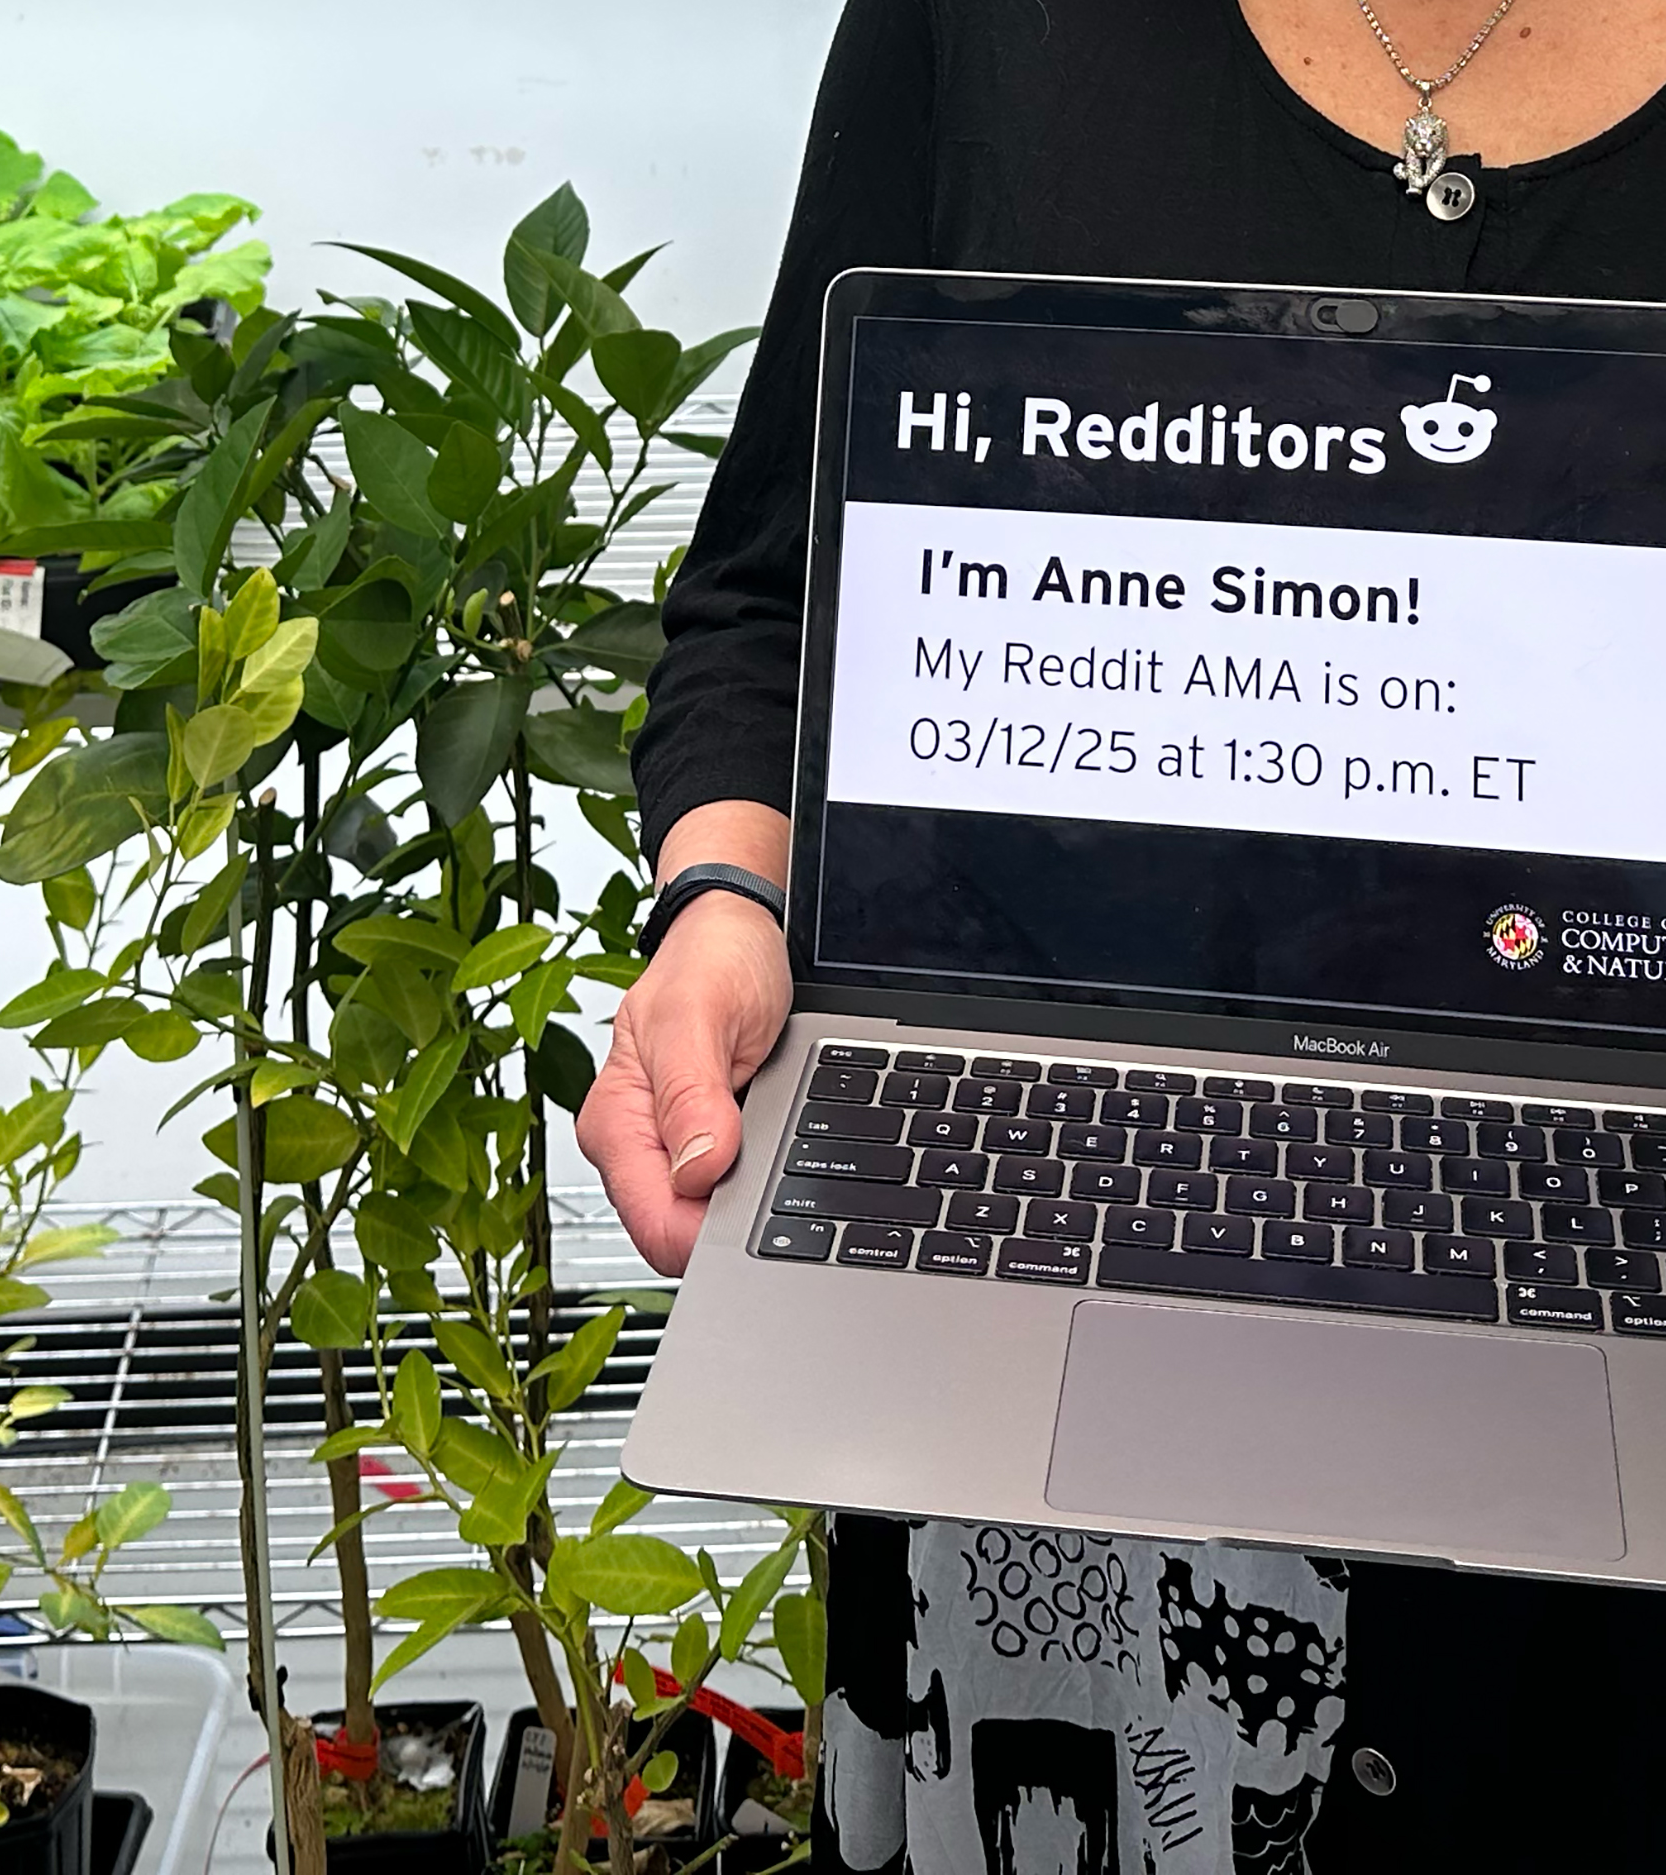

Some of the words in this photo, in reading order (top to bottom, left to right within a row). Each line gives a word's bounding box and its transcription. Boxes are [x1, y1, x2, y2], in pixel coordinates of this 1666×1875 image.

[897, 391, 992, 463] Hi,
[1022, 397, 1386, 475] Redditors
[921, 548, 1008, 599] I'm
[1032, 556, 1186, 610] Anne
[1210, 565, 1419, 626] Simon!
[915, 636, 984, 692] My
[1003, 642, 1164, 694] Reddit
[1183, 654, 1302, 703] AMA
[1324, 661, 1359, 707] is
[1380, 676, 1456, 714] on:
[910, 717, 1137, 774] 03/12/25
[1157, 735, 1205, 779] at
[1224, 738, 1323, 787] 1:30
[1344, 757, 1449, 800] p.m.
[1473, 755, 1536, 802] ET
[1562, 910, 1651, 929] COLLEGE
[1486, 946, 1544, 971] MARYLAND
[1562, 957, 1582, 975] &
[1293, 1034, 1366, 1057] MacBook
[1368, 1041, 1390, 1058] Air
[808, 1122, 829, 1131] tab
[936, 1124, 951, 1136] Q
[1008, 1129, 1028, 1141] W
[1085, 1136, 1098, 1148] E
[1160, 1143, 1174, 1154] R
[1238, 1150, 1250, 1161] T
[796, 1160, 827, 1169] caps
[830, 1161, 857, 1171] lock
[1313, 1156, 1327, 1168] Y
[945, 1163, 960, 1175] A
[1022, 1169, 1036, 1181] S
[1389, 1163, 1405, 1175] U
[1098, 1176, 1113, 1187] D
[1176, 1183, 1189, 1194] F
[1625, 1183, 1639, 1194] P
[1252, 1190, 1268, 1202] G
[784, 1198, 816, 1209] shift
[1331, 1197, 1346, 1209] H
[975, 1206, 990, 1218] Z
[1412, 1204, 1424, 1215] J
[1053, 1213, 1068, 1225] X
[1490, 1211, 1504, 1223] K
[810, 1223, 825, 1233] fn
[1132, 1220, 1146, 1232] C
[1571, 1217, 1584, 1230] L
[1210, 1227, 1226, 1239] V
[1290, 1234, 1305, 1246] B
[848, 1247, 898, 1258] control
[1370, 1241, 1386, 1254] N
[932, 1254, 978, 1265] option
[1450, 1248, 1468, 1261] M
[1008, 1261, 1078, 1275] command
[1519, 1308, 1592, 1321] command
